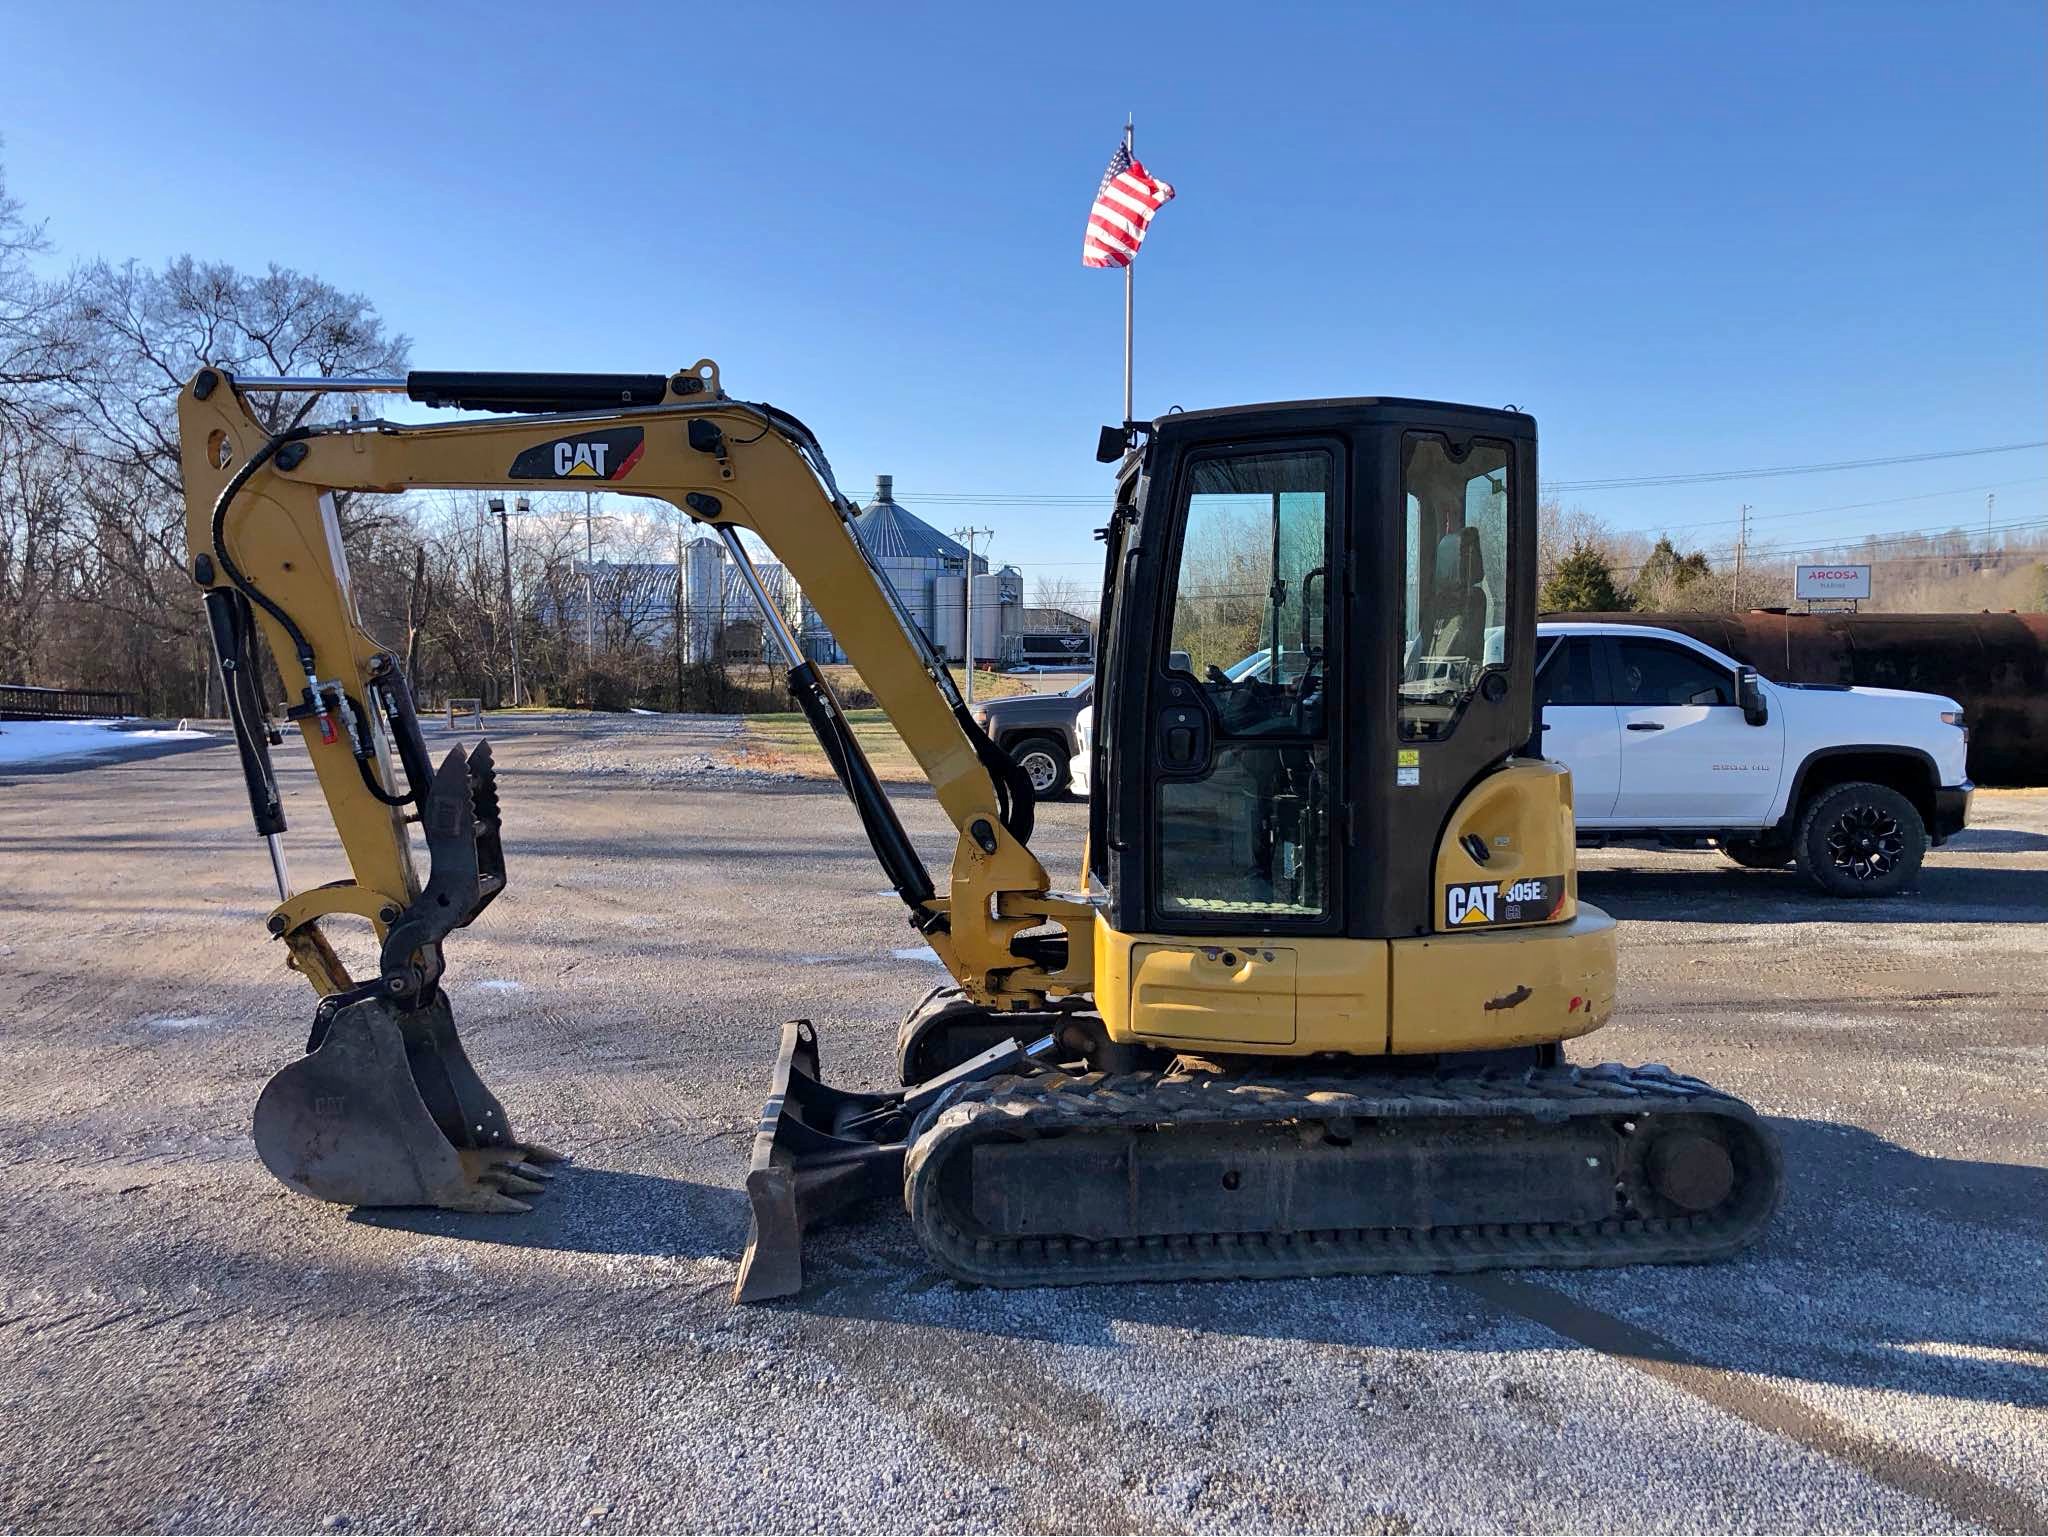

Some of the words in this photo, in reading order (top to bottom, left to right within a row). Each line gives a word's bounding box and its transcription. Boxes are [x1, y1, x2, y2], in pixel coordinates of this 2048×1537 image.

[554, 442, 609, 477] CAT
[1808, 571, 1858, 580] ARCOSA
[1448, 885, 1499, 925] CAT
[1505, 904, 1521, 920] CR
